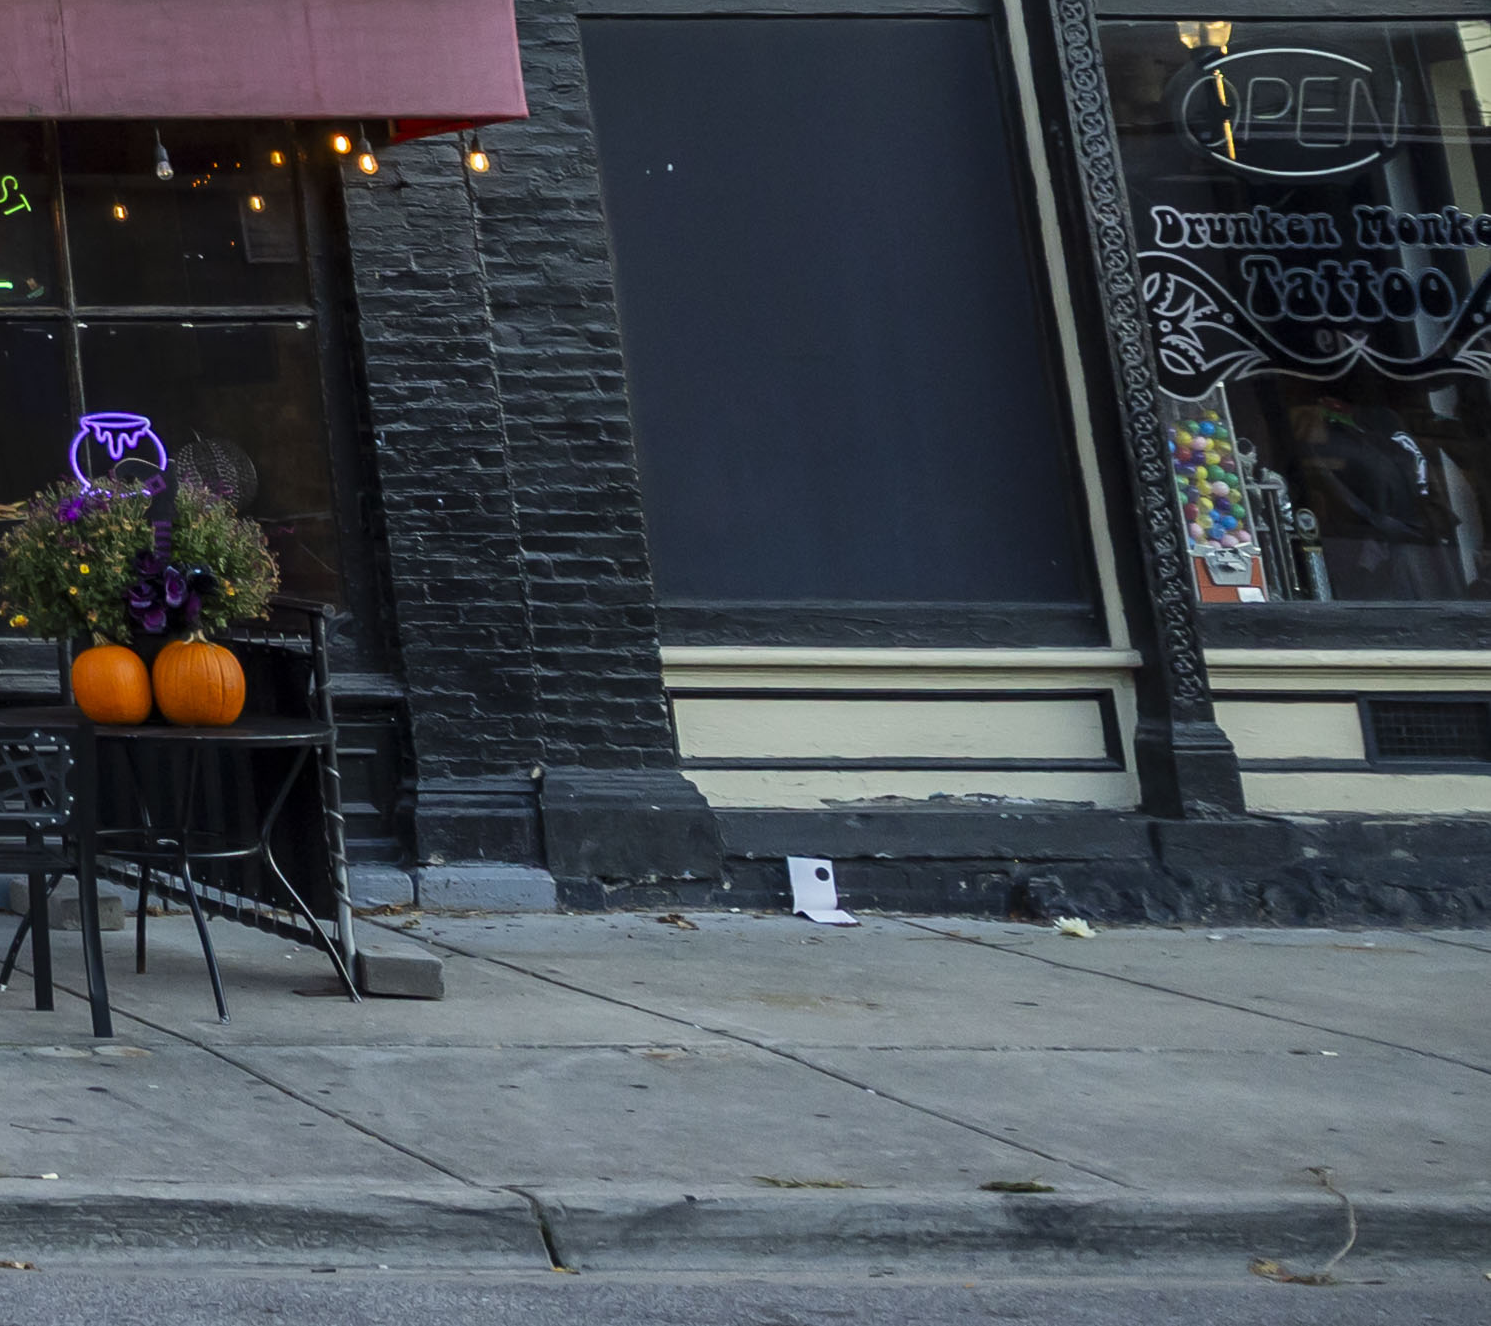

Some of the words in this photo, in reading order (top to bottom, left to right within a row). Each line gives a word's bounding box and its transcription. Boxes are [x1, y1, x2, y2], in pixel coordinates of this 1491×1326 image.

[1181, 74, 1402, 148] OPEN
[1150, 205, 1342, 249] Drunken
[1241, 255, 1458, 322] Tattoo
